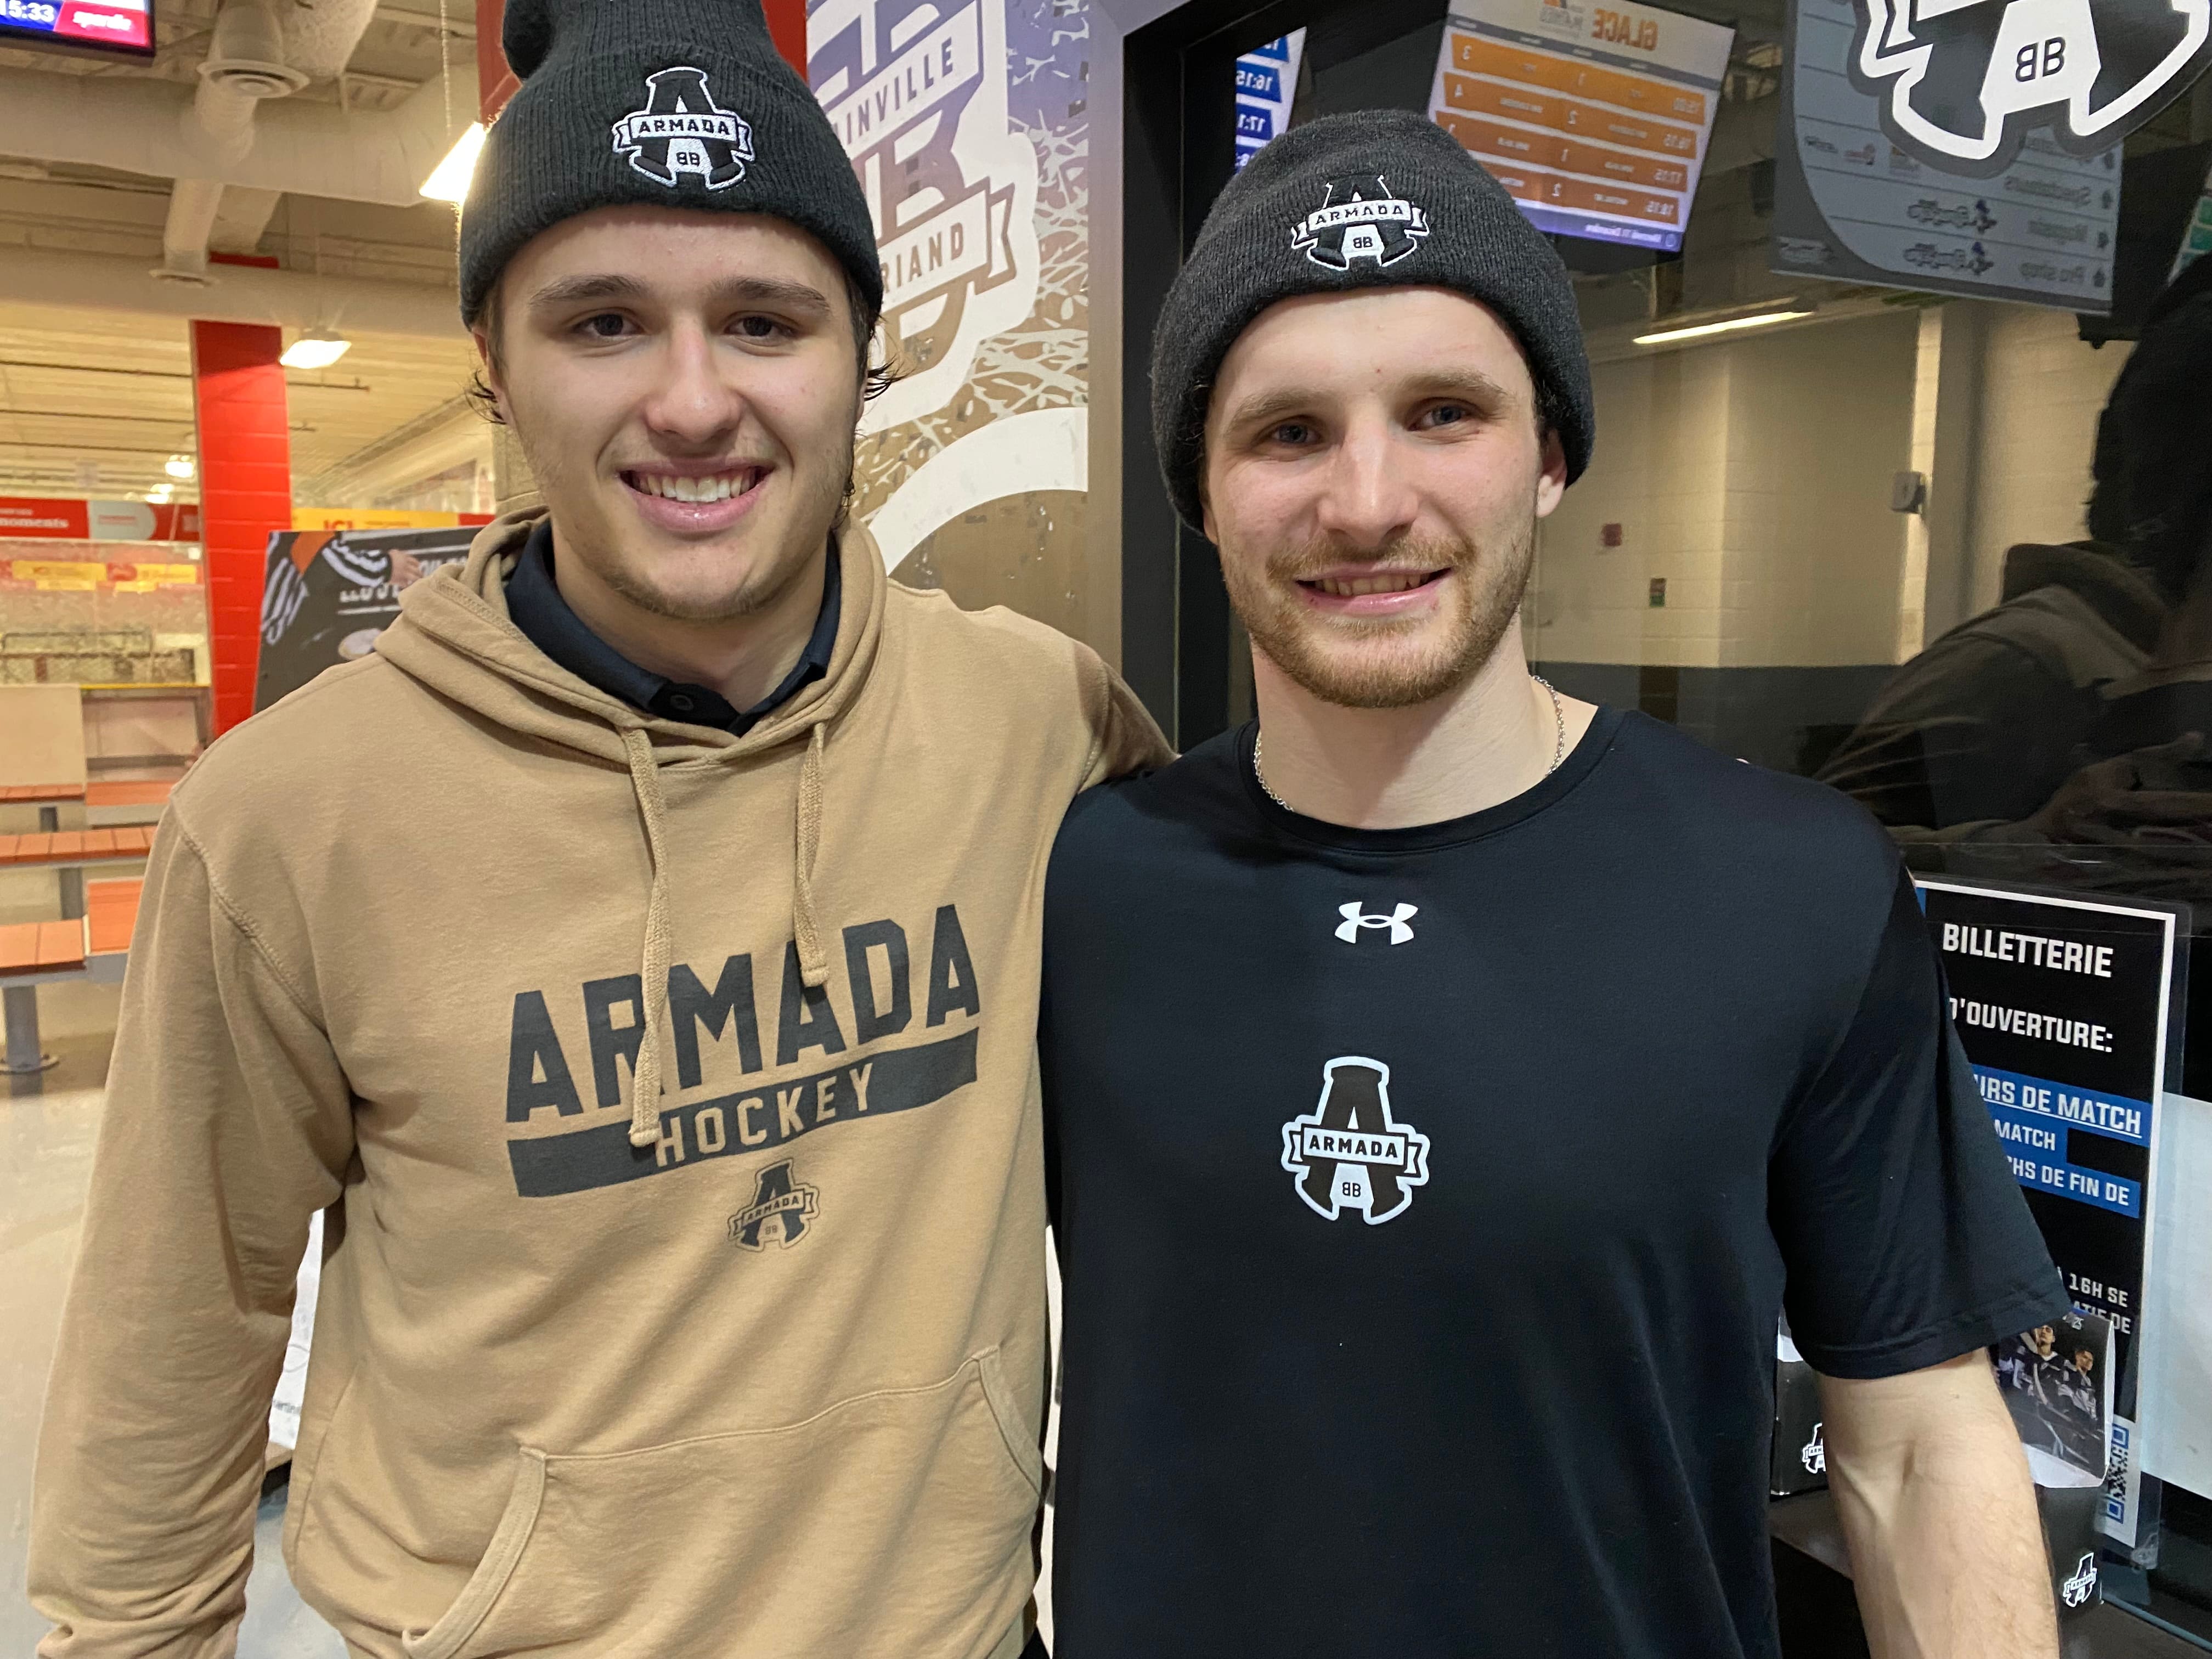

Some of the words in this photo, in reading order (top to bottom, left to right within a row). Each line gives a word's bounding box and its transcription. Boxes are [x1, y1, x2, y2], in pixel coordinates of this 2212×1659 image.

[833, 36, 953, 145] INVILLE
[639, 119, 731, 135] ARMADA
[1315, 204, 1403, 225] ARMADA
[1942, 923, 2114, 978] BILLETTERIE
[506, 904, 980, 1123] ARMADA
[656, 1063, 873, 1167] HOCKEY
[2022, 1085, 2052, 1113] DE
[2058, 1093, 2141, 1134] MATCH
[1308, 1135, 1398, 1159] ARMADA
[1994, 1119, 2056, 1152] MATCH
[2006, 1155, 2036, 1180] HS
[2041, 1165, 2065, 1188] DE
[2069, 1172, 2100, 1198] FIN
[2105, 1182, 2130, 1206] DE
[748, 1195, 800, 1221] ARMADA
[2069, 1273, 2103, 1299] 16H
[2108, 1286, 2129, 1308] SE
[2111, 1312, 2131, 1335] DE
